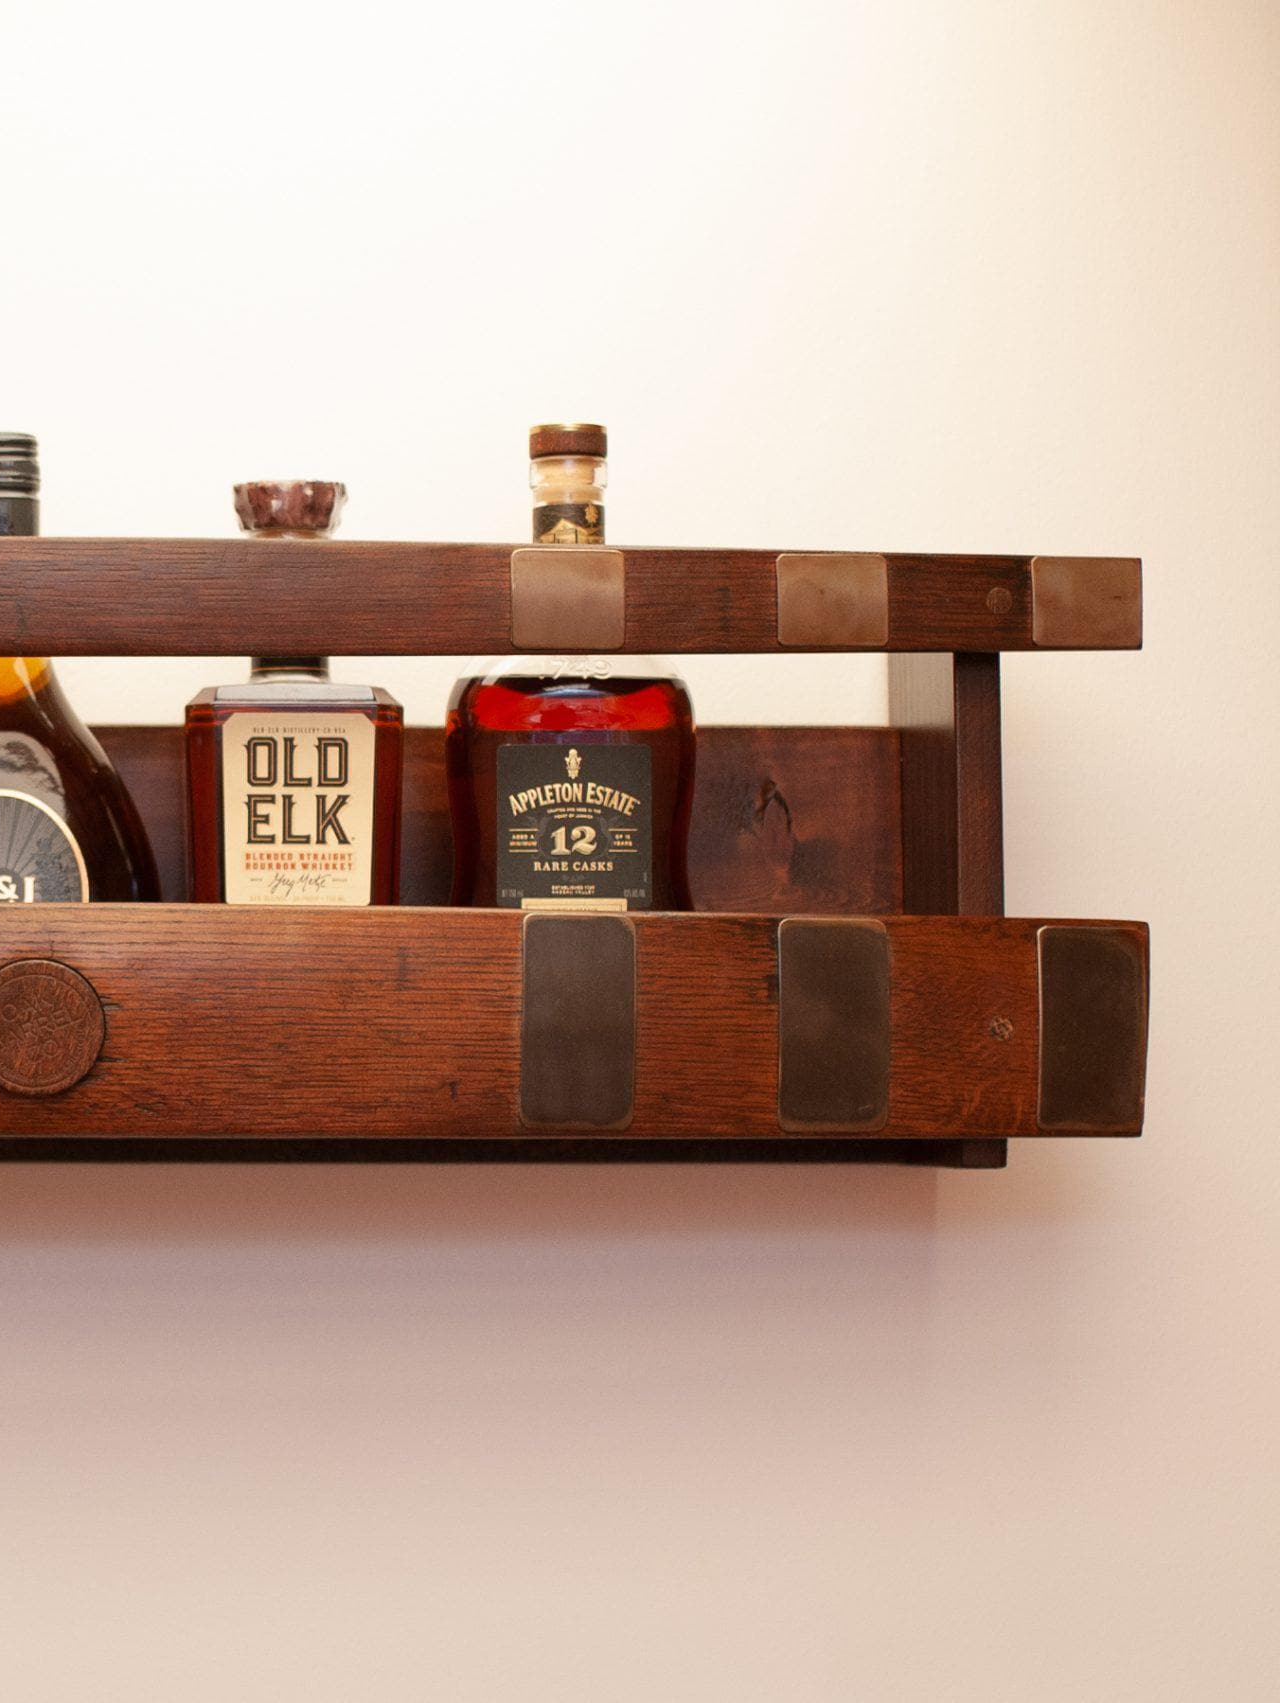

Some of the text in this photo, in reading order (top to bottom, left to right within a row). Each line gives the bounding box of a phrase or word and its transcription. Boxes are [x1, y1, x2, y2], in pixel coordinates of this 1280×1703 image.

[244, 737, 349, 788] OLD
[508, 782, 638, 816] APPLETON ESTATE
[244, 794, 351, 845] ELK
[550, 826, 598, 855] 12
[245, 853, 352, 861] BLENDED STRAIGHT
[533, 861, 614, 872] RARE CASKS
